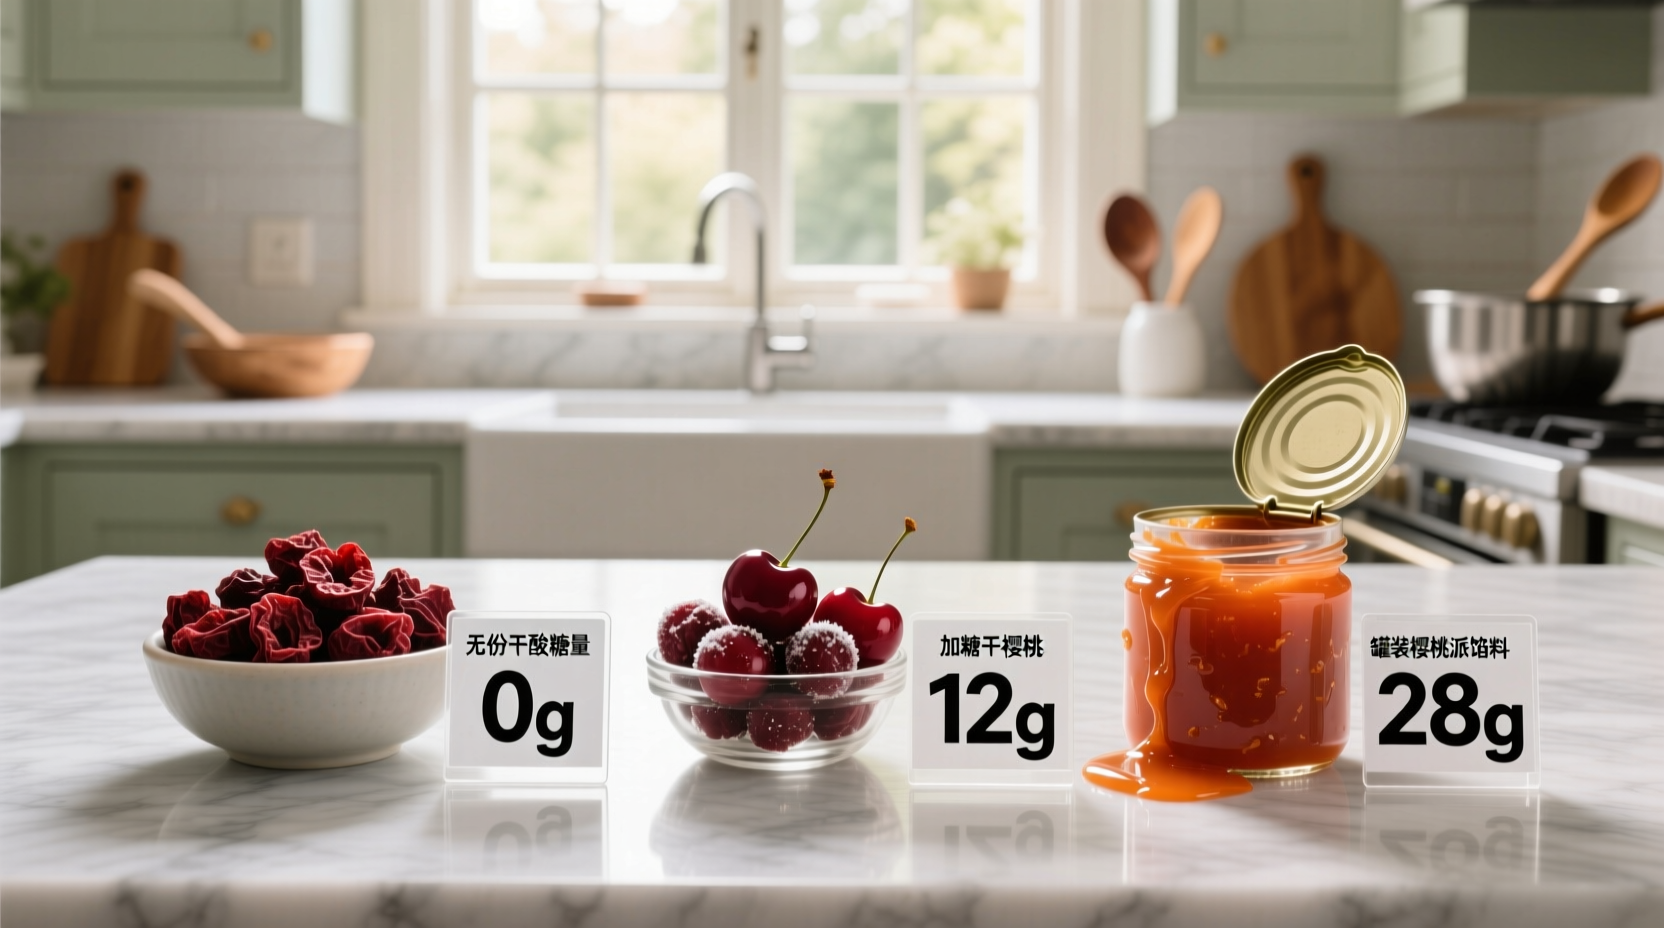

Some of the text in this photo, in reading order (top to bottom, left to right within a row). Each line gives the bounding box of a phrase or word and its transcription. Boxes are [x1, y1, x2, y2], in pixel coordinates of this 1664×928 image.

[466, 633, 591, 657] 无份干酸糖量
[940, 634, 1044, 658] 加糖干樱桃
[1370, 635, 1510, 659] 罐装樱桃派馅料
[481, 670, 575, 758] 0g
[929, 672, 1056, 760] 12g
[1378, 672, 1524, 763] 28g
